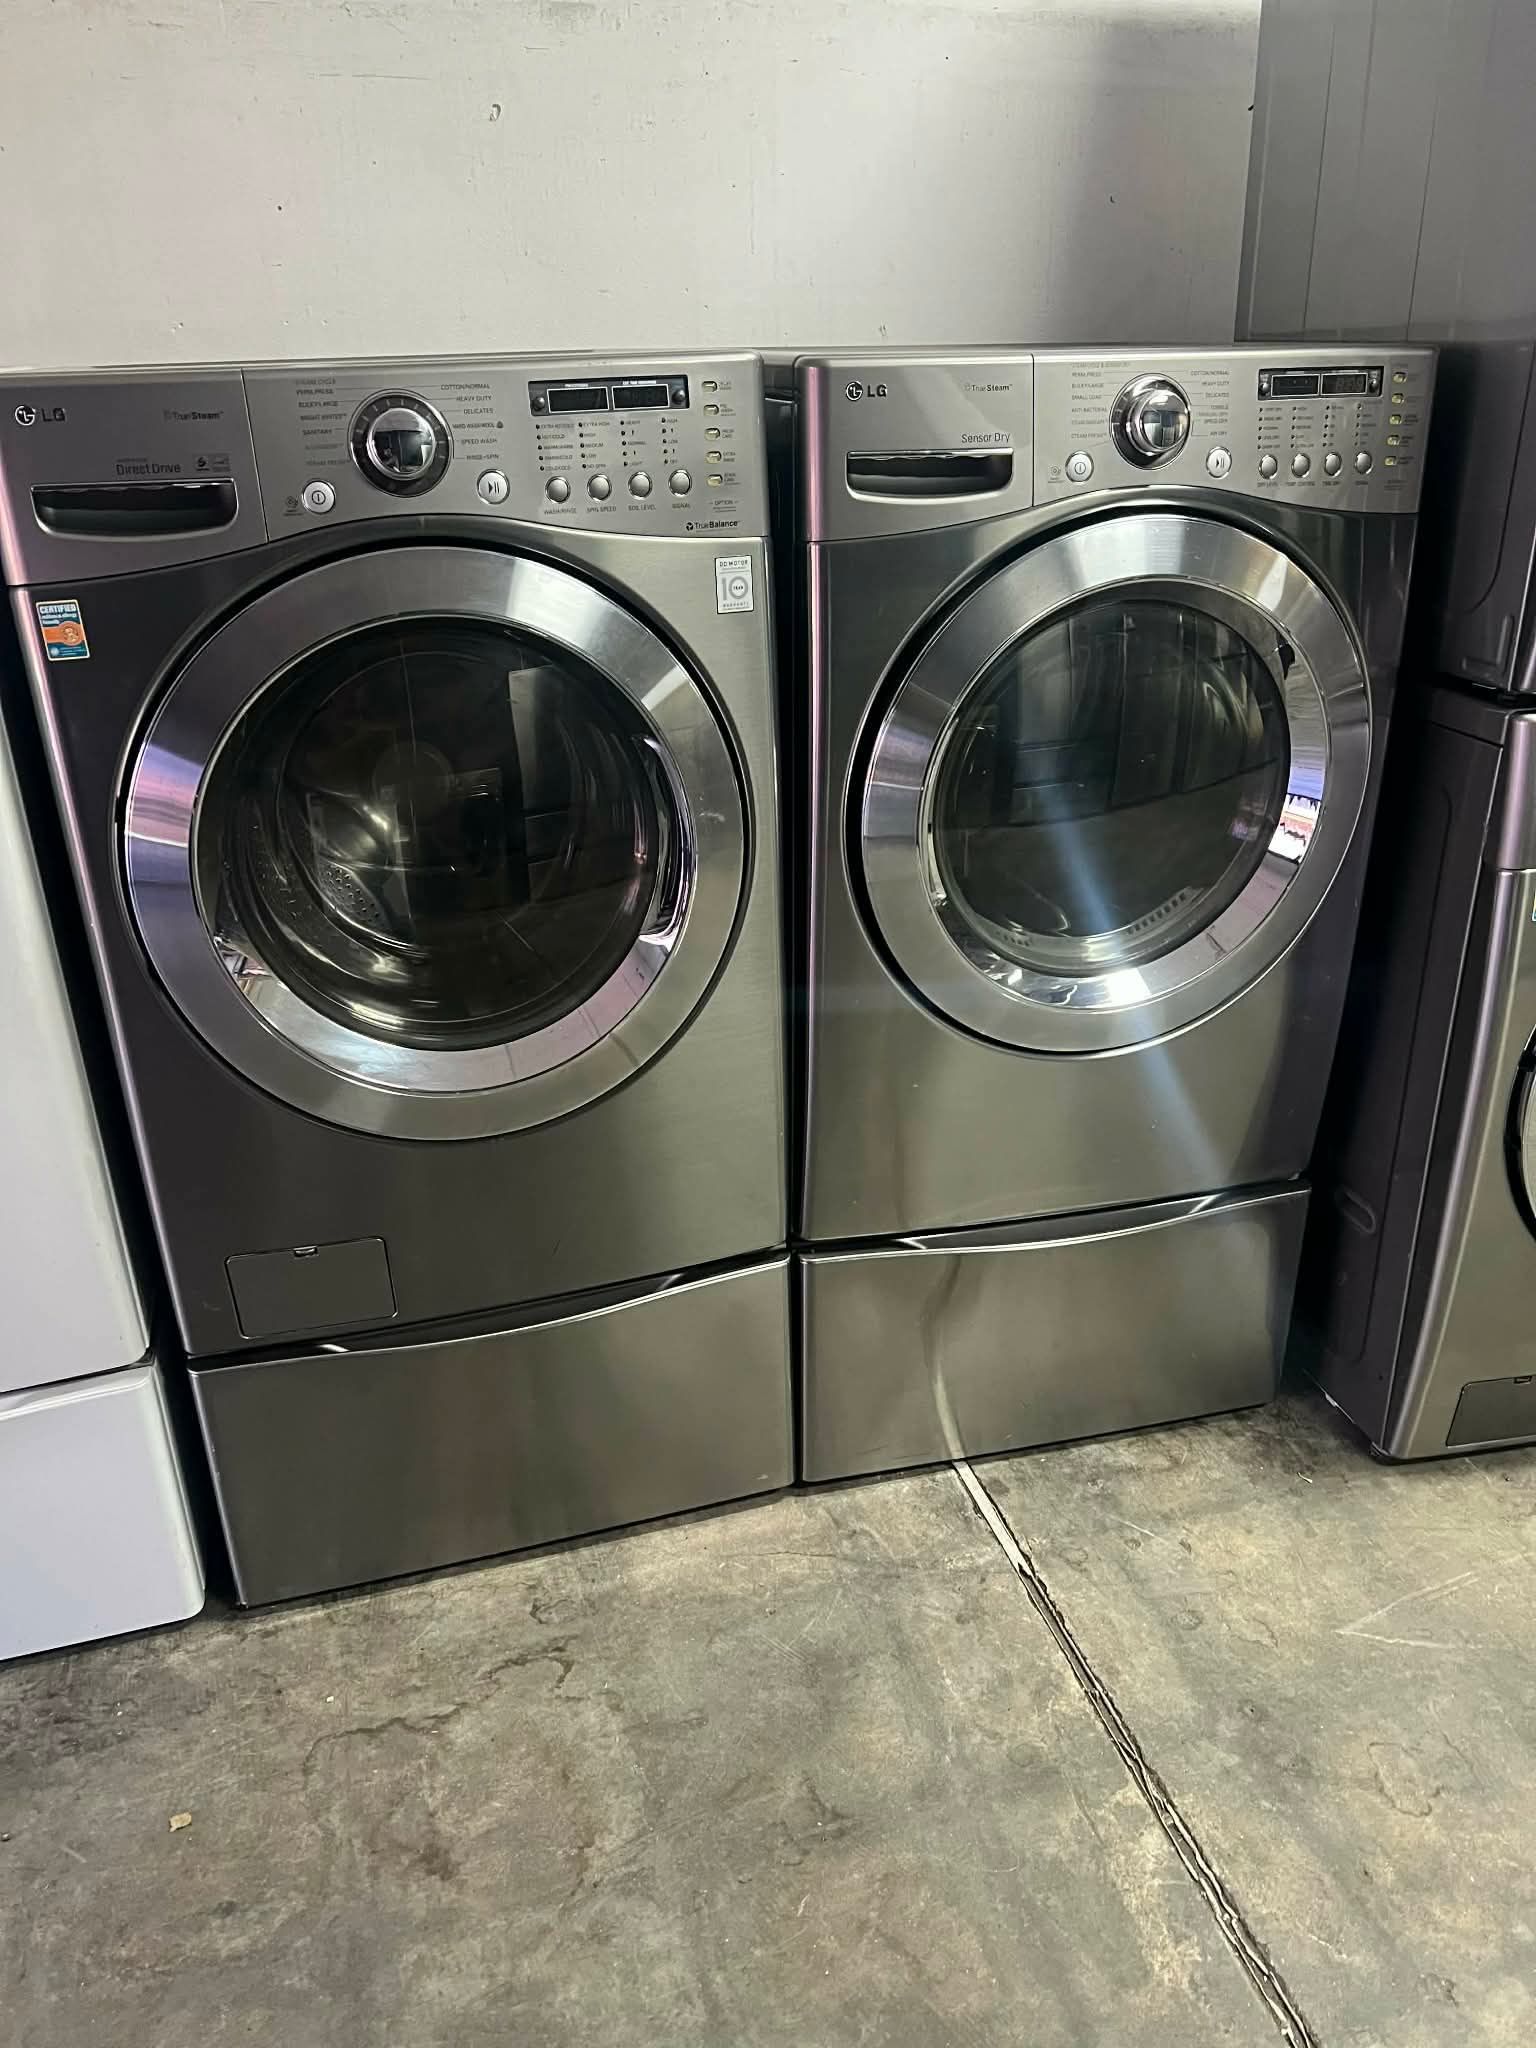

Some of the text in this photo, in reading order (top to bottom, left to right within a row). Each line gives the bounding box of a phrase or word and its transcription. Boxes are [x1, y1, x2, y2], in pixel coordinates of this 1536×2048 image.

[866, 384, 887, 397] LG
[42, 408, 66, 422] LG
[463, 407, 494, 415] DELICATES
[961, 432, 1011, 445] Sensor Dry
[116, 462, 181, 476] Direct Drive
[694, 520, 738, 530] TrueBalance
[721, 575, 749, 601] 10
[40, 604, 76, 614] CERTIFIED
